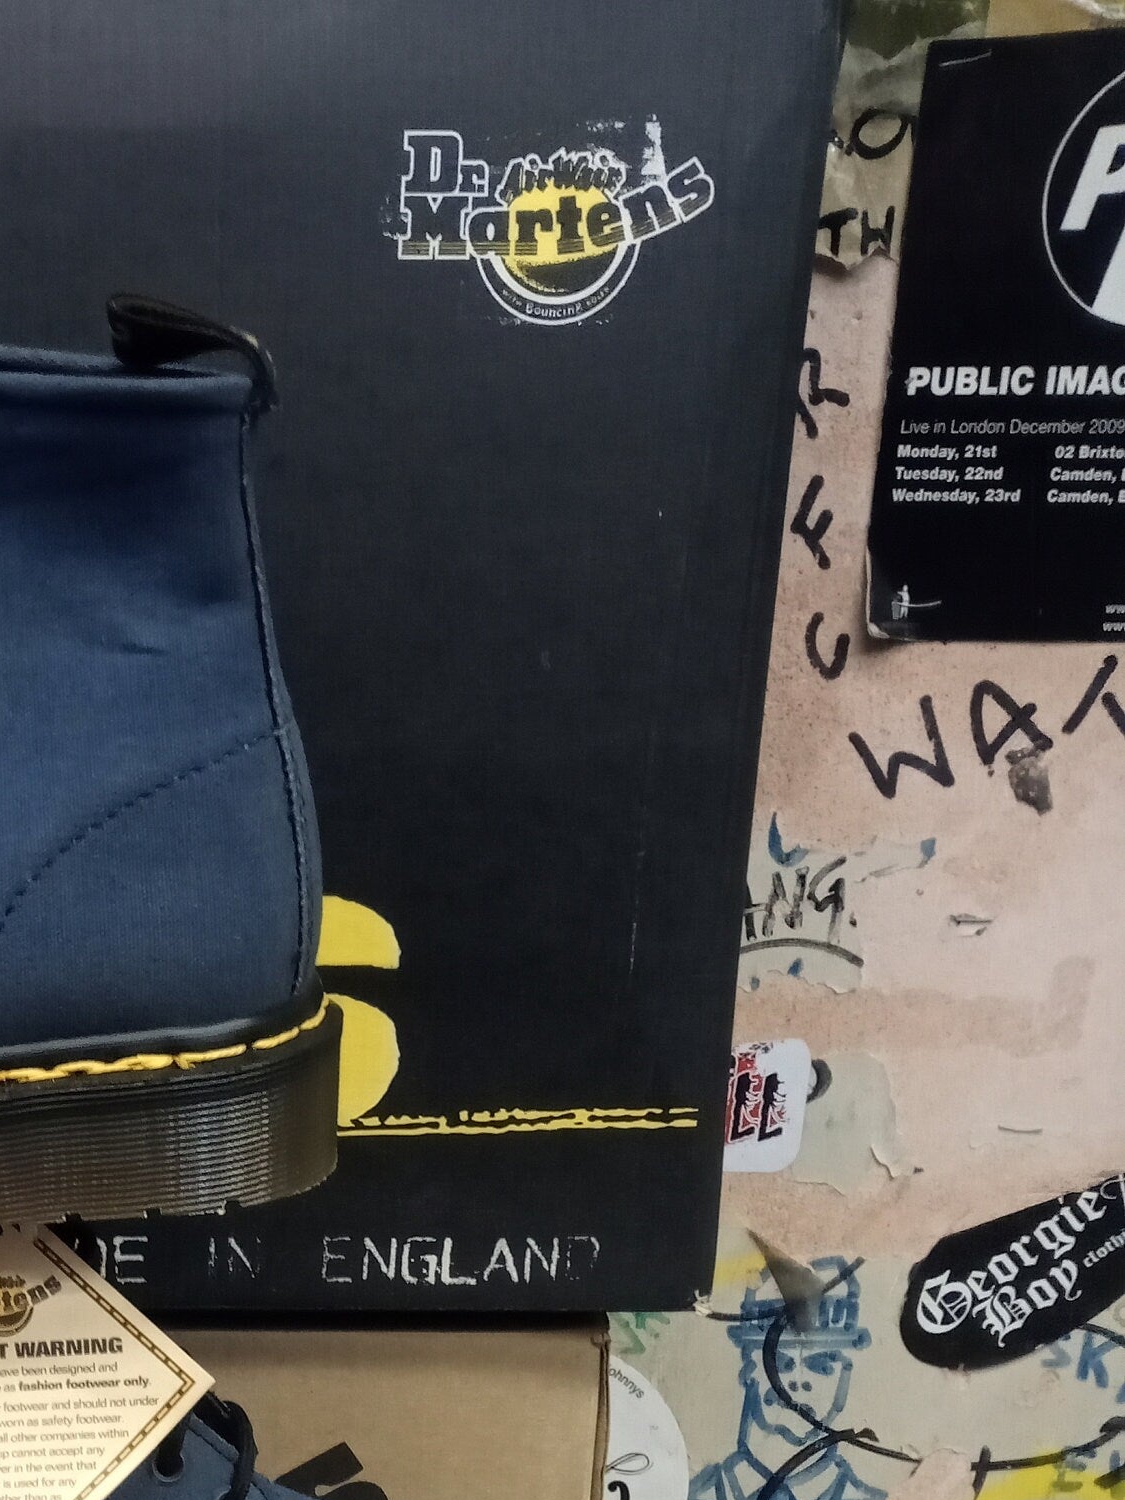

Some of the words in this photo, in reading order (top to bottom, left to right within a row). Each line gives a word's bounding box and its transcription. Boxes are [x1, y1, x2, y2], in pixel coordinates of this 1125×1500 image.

[398, 156, 714, 260] Martens
[525, 301, 584, 319] Bouncing
[905, 366, 1034, 395] PUBLIC
[900, 420, 929, 433] Live
[933, 422, 945, 433] in
[951, 420, 1004, 433] London
[1009, 419, 1085, 434] December
[897, 444, 958, 460] Monday,
[964, 445, 996, 457] 21st
[895, 466, 959, 482] Tuesday,
[964, 467, 1003, 480] 22nd
[1050, 467, 1116, 482] Camden,
[892, 488, 979, 503] Wednesday,
[984, 489, 1020, 501] 23rd
[1047, 490, 1113, 504] Camden,
[917, 1191, 1107, 1334] Georgie
[972, 1259, 1082, 1348] Boy
[15, 1338, 122, 1357] WARNING
[21, 1365, 46, 1376] been
[49, 1362, 95, 1376] designed
[98, 1361, 117, 1373] and
[4, 1384, 15, 1392] as
[19, 1379, 62, 1391] fashion
[66, 1378, 120, 1389] footwear
[123, 1375, 150, 1389] only.
[3, 1401, 47, 1412] footwear
[51, 1398, 70, 1410] and
[73, 1397, 107, 1410] should
[109, 1397, 125, 1408] not
[129, 1395, 159, 1407] under
